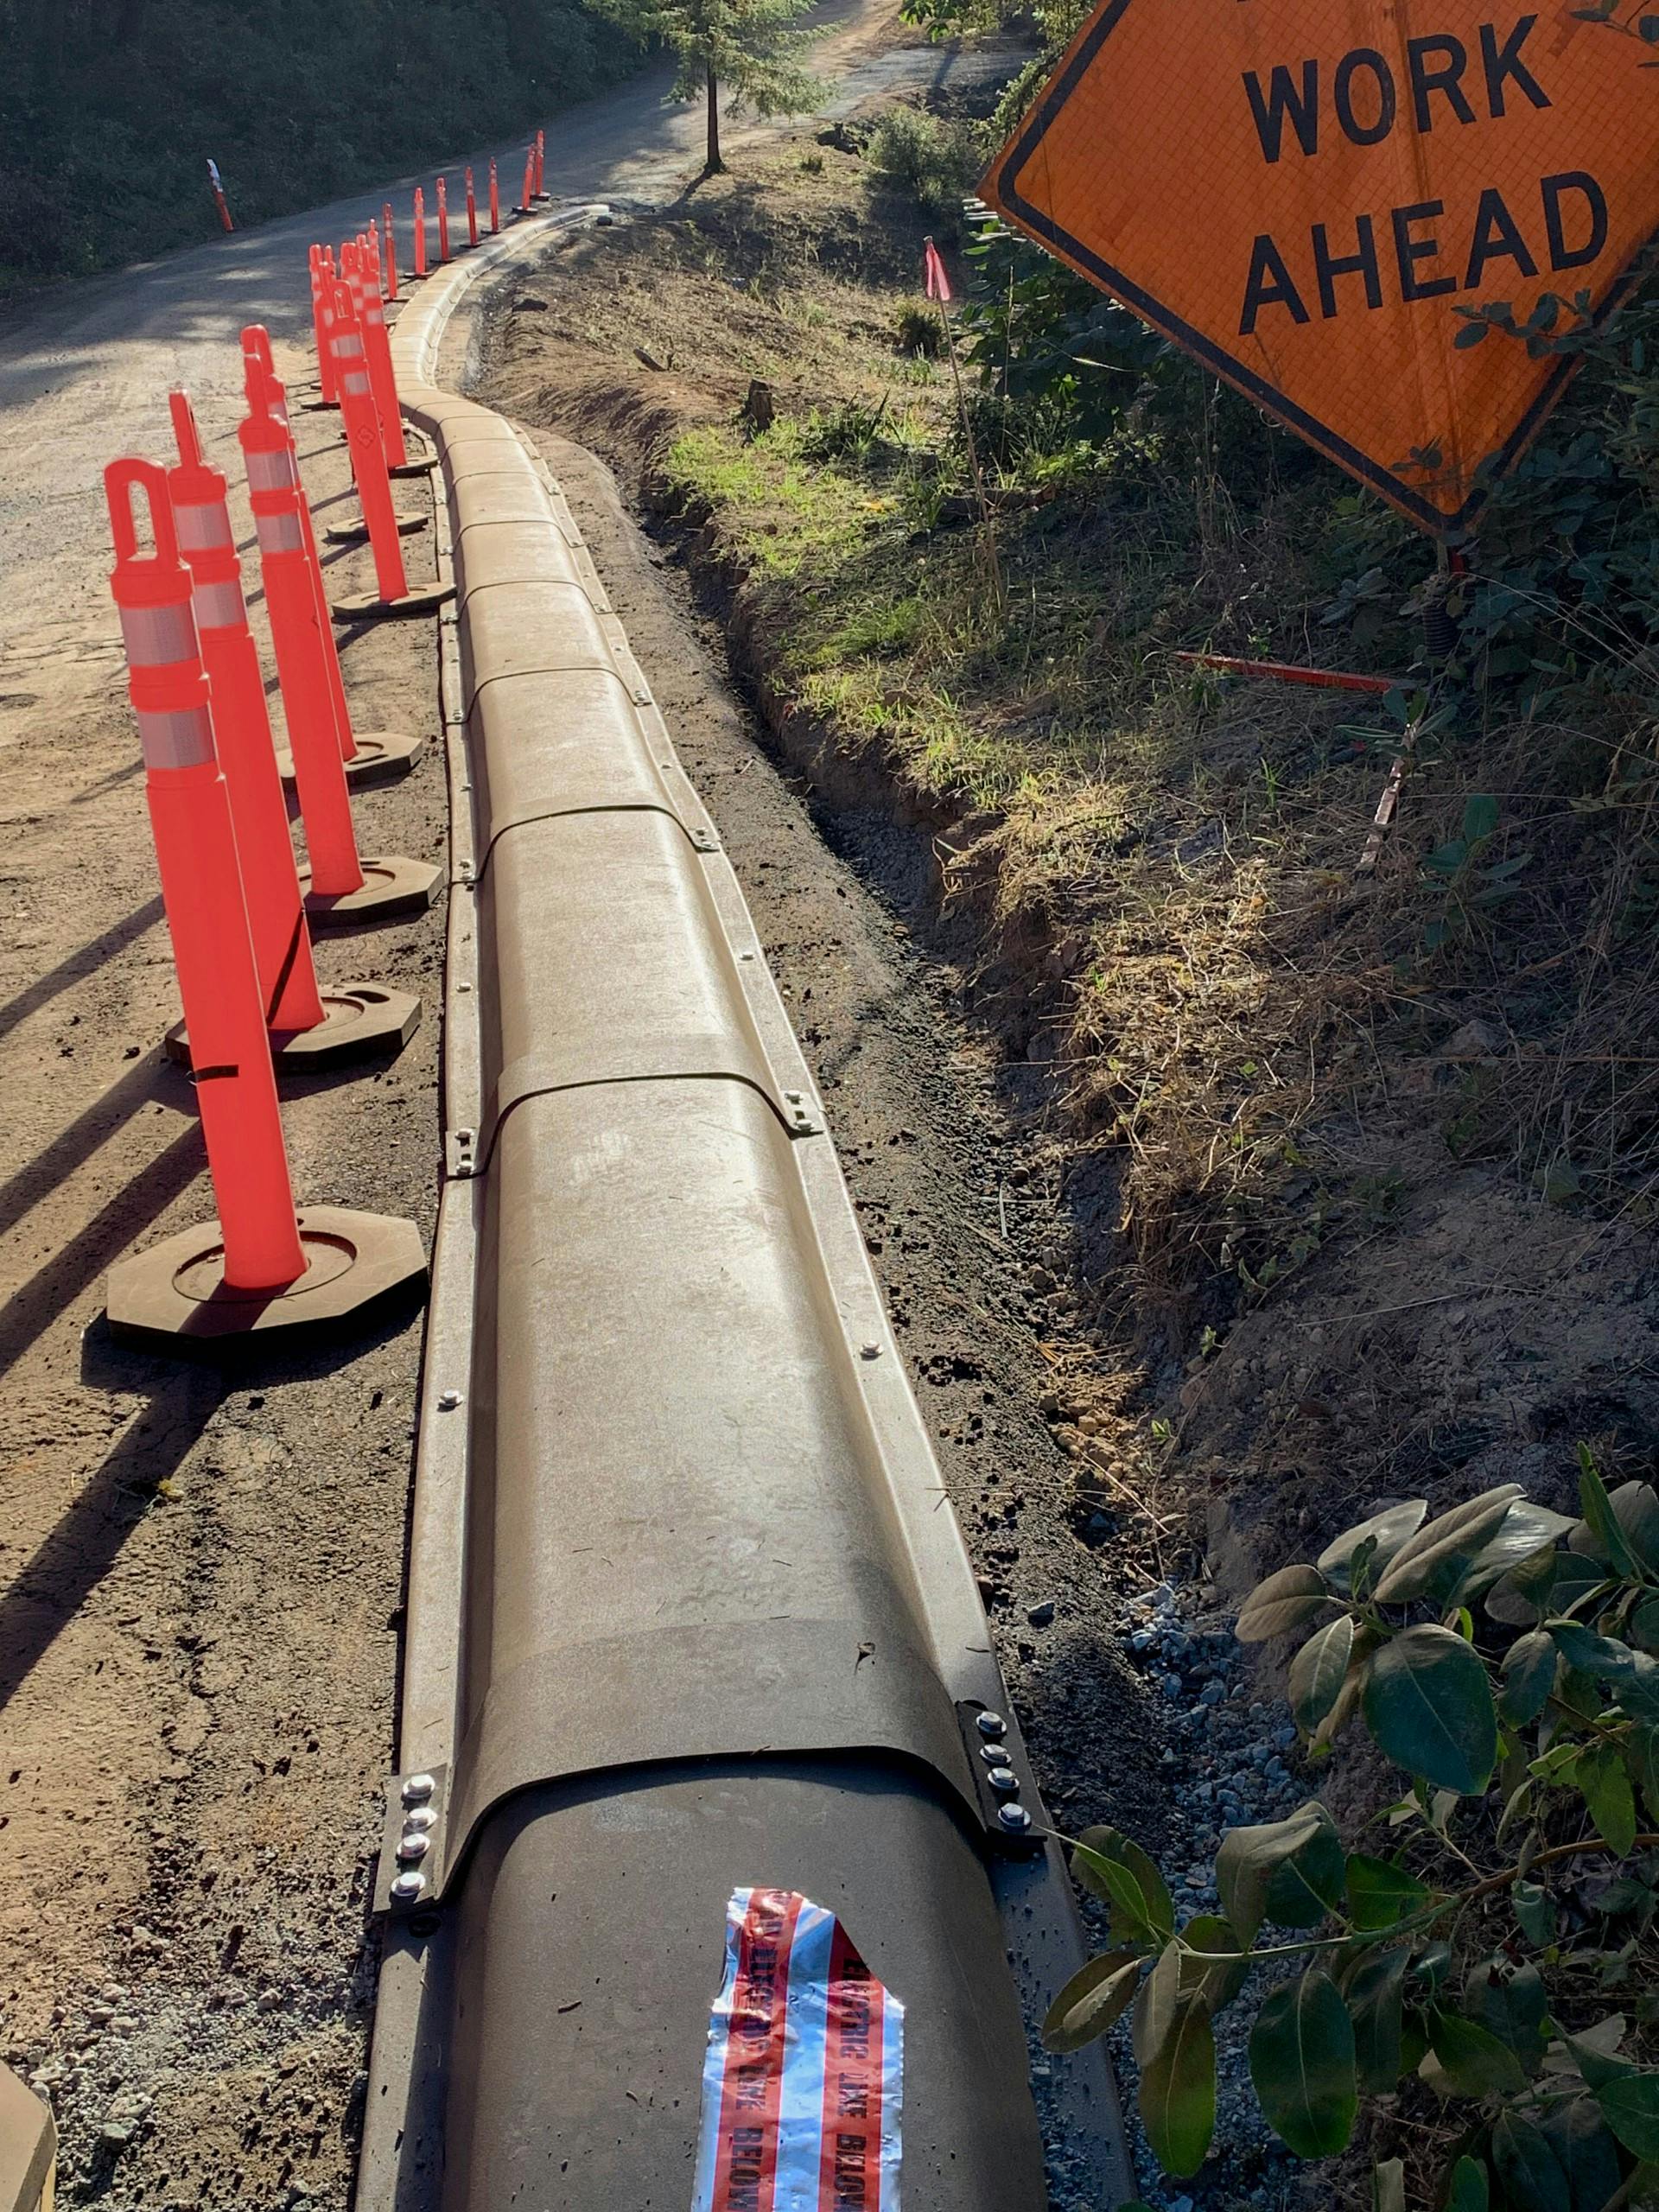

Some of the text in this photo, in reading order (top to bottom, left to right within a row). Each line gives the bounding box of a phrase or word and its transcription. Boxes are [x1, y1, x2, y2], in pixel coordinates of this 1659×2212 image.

[1242, 14, 1553, 162] WORK
[1238, 171, 1609, 335] AHEAD
[839, 1957, 871, 2059] ELECTRIC
[838, 2072, 868, 2119] LINE
